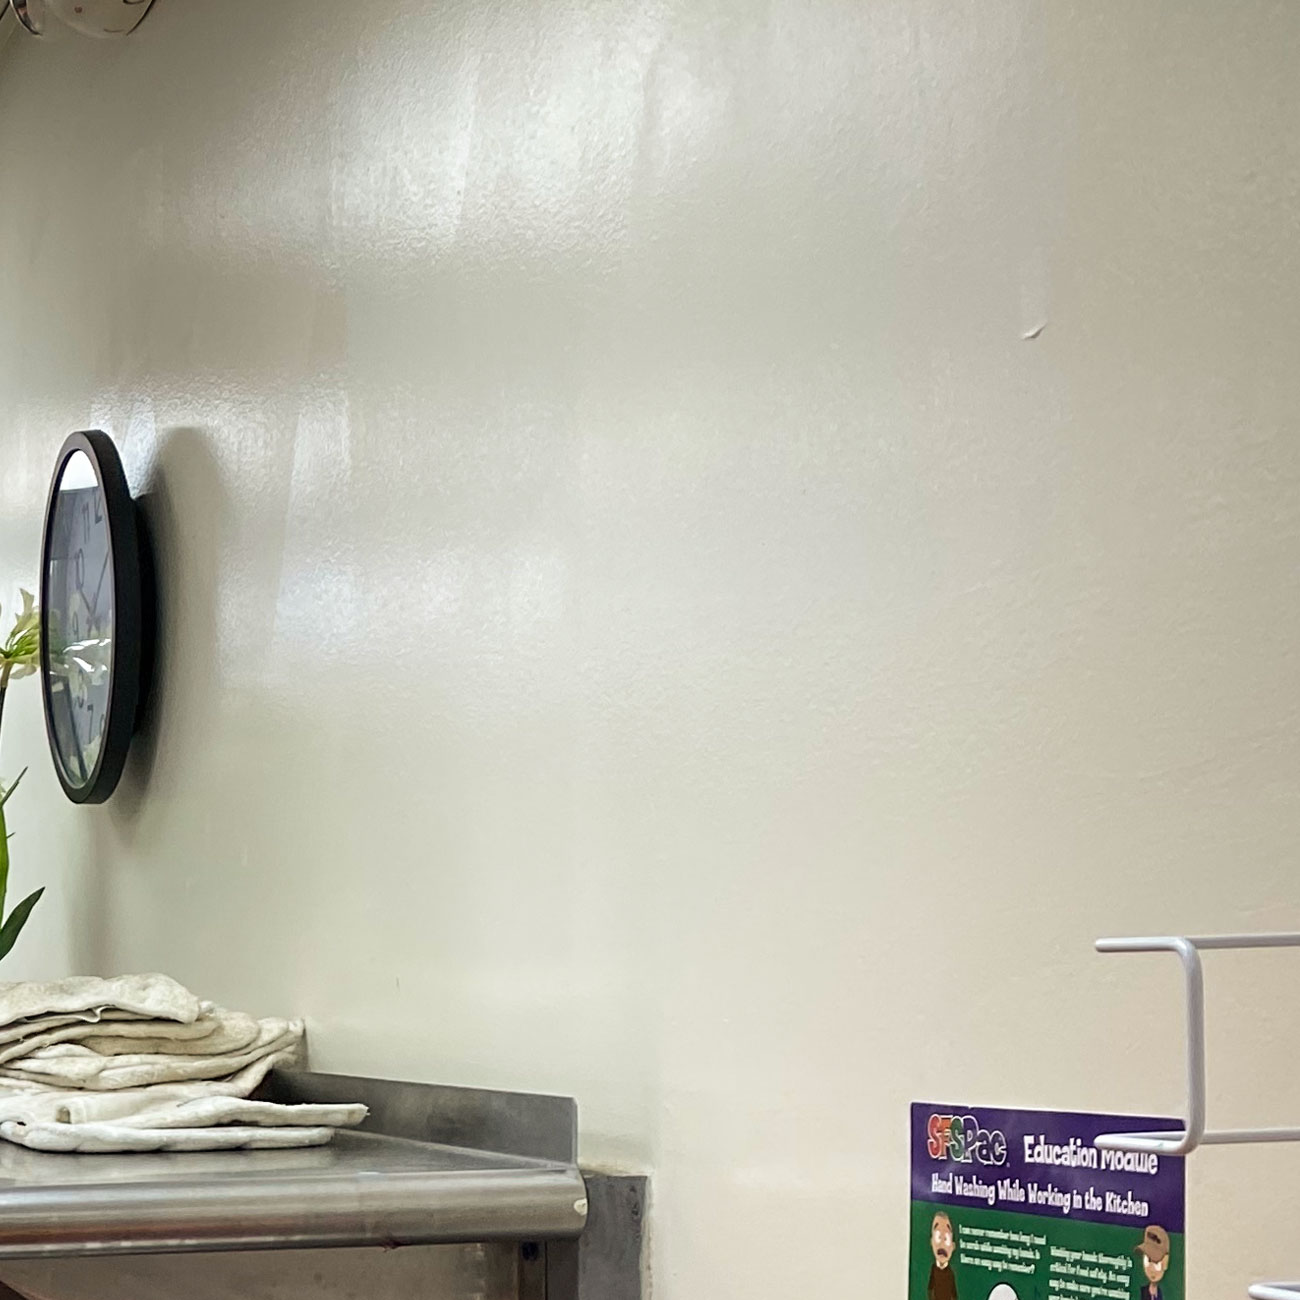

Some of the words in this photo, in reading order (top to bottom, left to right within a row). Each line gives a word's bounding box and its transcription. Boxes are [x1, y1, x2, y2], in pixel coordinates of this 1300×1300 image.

[1023, 1134, 1097, 1170] Education
[931, 1173, 952, 1195] Hand
[954, 1175, 995, 1205] Washing
[997, 1178, 1025, 1202] While
[1028, 1182, 1070, 1214] Working
[1073, 1187, 1082, 1205] in
[1084, 1186, 1102, 1211] the
[1105, 1191, 1148, 1217] Kitchen
